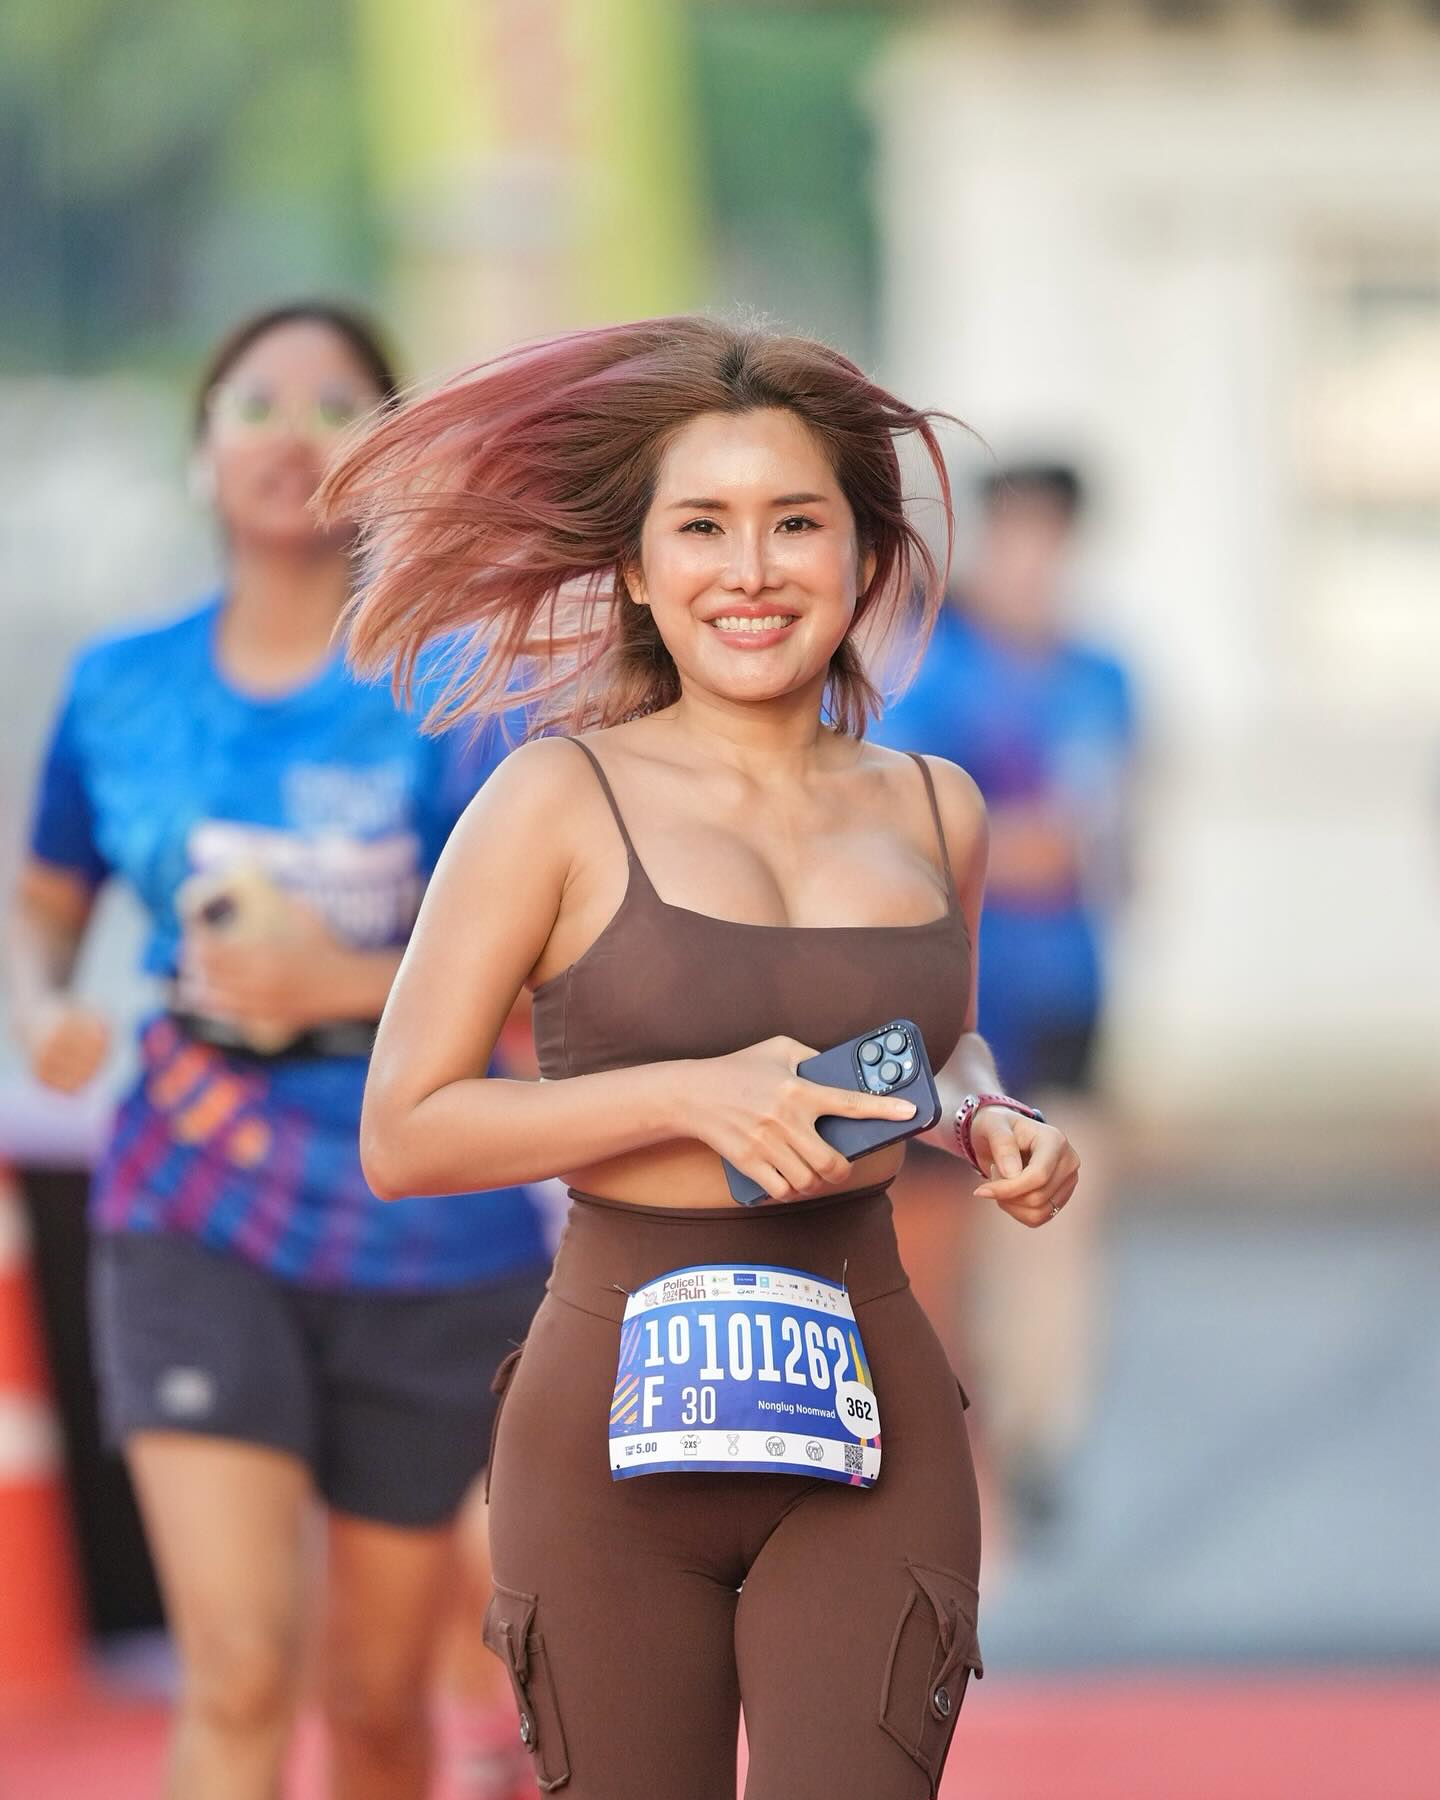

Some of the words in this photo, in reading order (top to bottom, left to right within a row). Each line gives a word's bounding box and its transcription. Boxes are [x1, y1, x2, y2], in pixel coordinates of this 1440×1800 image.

[663, 1279, 694, 1291] Police
[663, 1289, 678, 1299] 2024
[679, 1288, 706, 1300] Run
[645, 1315, 690, 1367] 10
[698, 1312, 849, 1390] 101262
[642, 1375, 664, 1428] F
[681, 1386, 716, 1424] 30
[758, 1400, 794, 1414] Nonglug
[796, 1404, 836, 1419] Noomwad
[846, 1397, 873, 1421] 362
[636, 1442, 657, 1454] 5.00
[684, 1441, 698, 1449] 2XS
